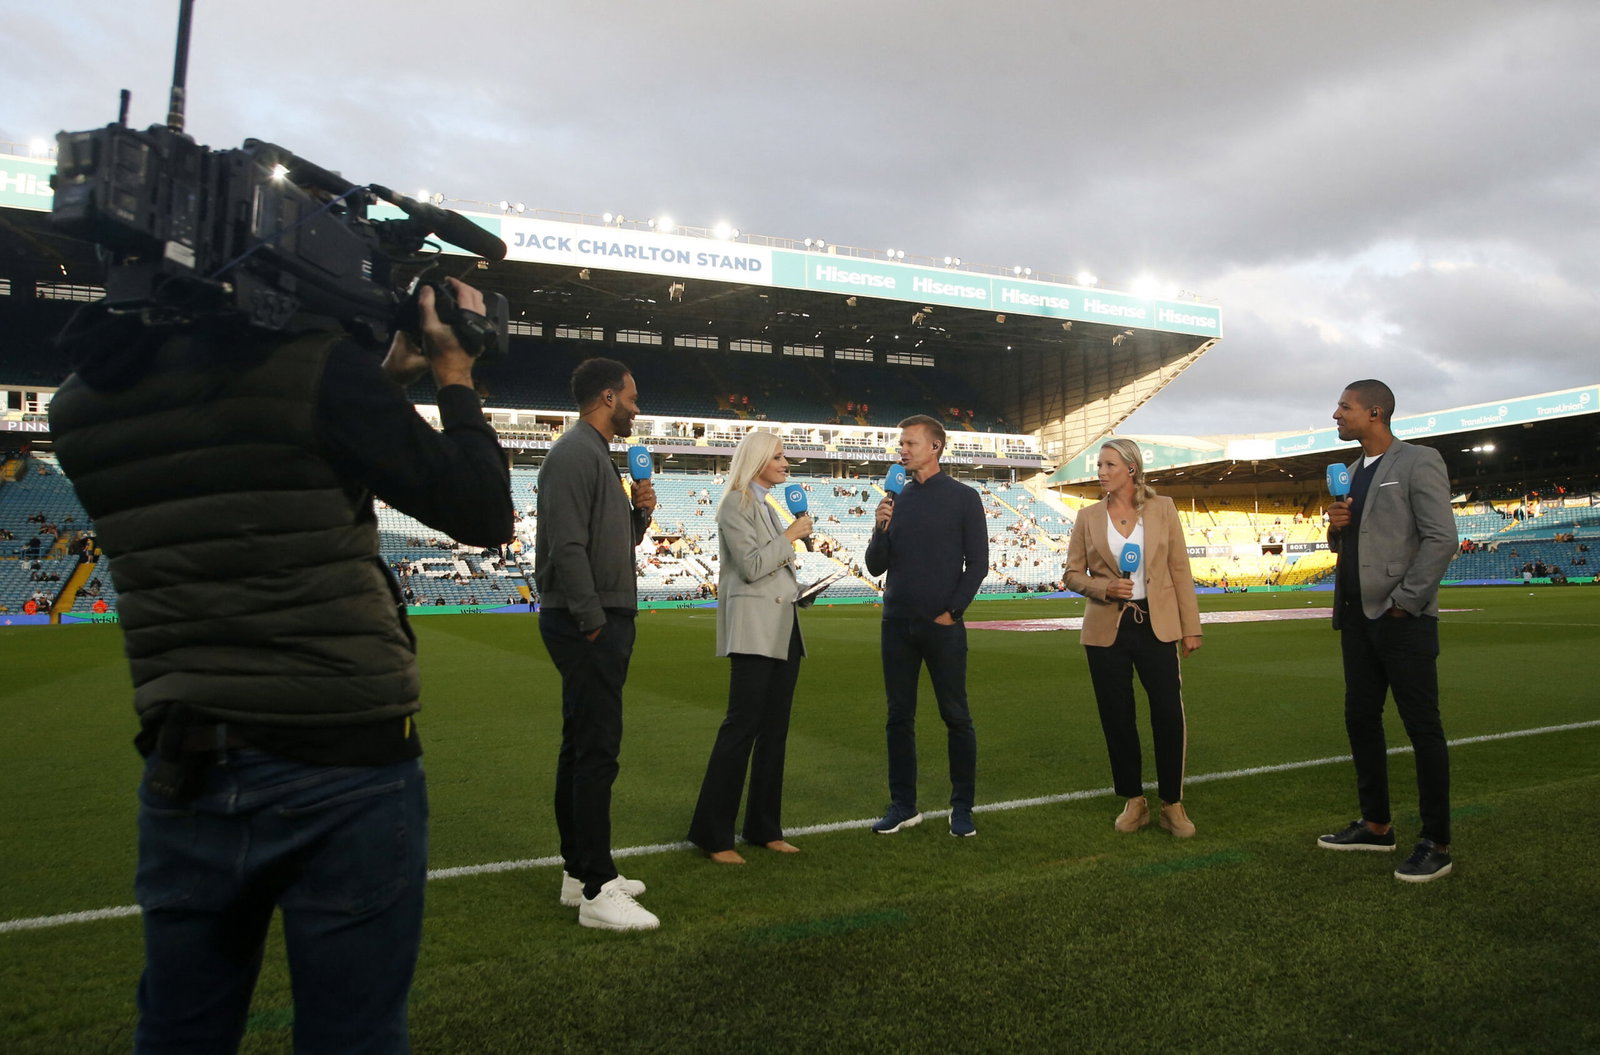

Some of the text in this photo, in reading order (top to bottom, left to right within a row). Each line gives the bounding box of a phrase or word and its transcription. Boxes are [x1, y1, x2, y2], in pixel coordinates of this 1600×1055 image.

[0, 170, 54, 197] His
[514, 232, 762, 272] JACK CHARLTON STAND
[815, 264, 896, 289] Hisense
[912, 276, 987, 300] Hisense
[1001, 287, 1070, 310] Hisense
[1083, 298, 1147, 319] Hisense
[1158, 308, 1216, 328] Hisense
[1537, 403, 1584, 416] TransUnion
[8, 421, 50, 432] PINN
[1460, 415, 1502, 427] TransUnion
[1394, 425, 1432, 436] TransUnion
[501, 440, 551, 449] NNACLE
[825, 452, 974, 464] THE PINNACLE EANING
[91, 615, 119, 624] wish
